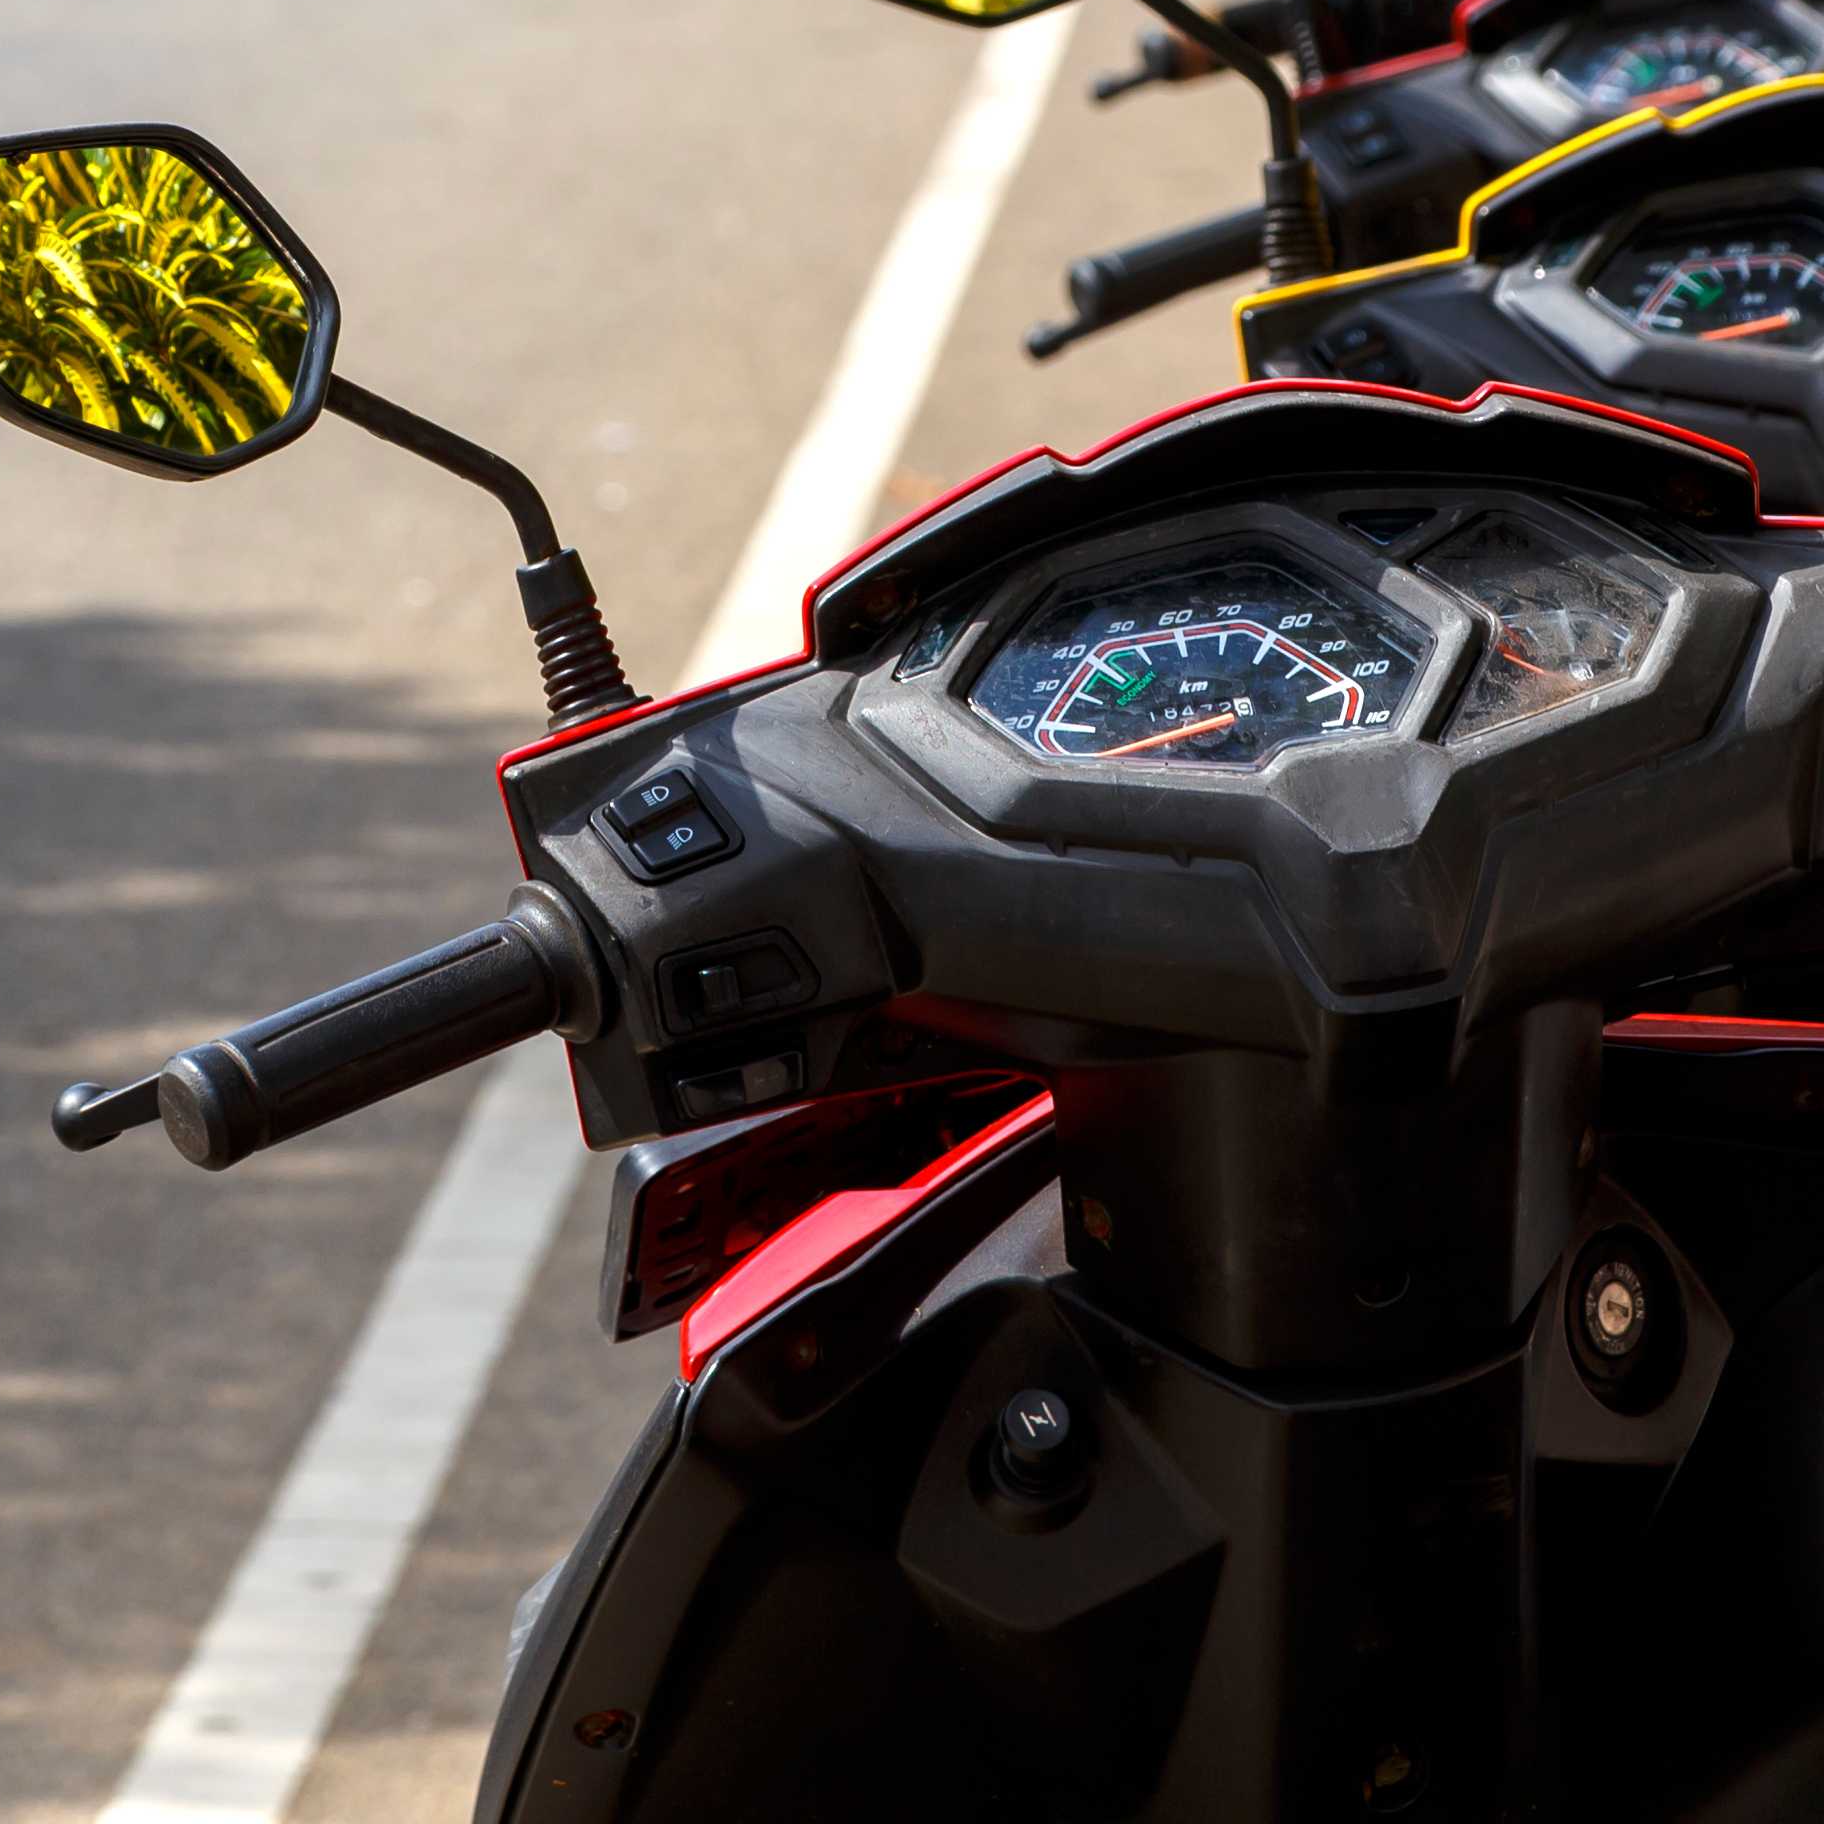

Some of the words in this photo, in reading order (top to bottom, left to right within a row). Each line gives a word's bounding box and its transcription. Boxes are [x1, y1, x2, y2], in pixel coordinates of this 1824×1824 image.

[1158, 609, 1193, 626] 60
[1216, 604, 1242, 618] 70
[1106, 620, 1136, 634] 50
[1278, 613, 1313, 630] 80
[1052, 644, 1086, 660] 40
[1319, 640, 1347, 654] 90
[1352, 660, 1390, 677] 100
[1033, 679, 1060, 694] 30
[1116, 670, 1158, 707] ECONOMY
[1179, 680, 1208, 695] km
[1003, 714, 1036, 730] 20
[1364, 710, 1391, 724] 110
